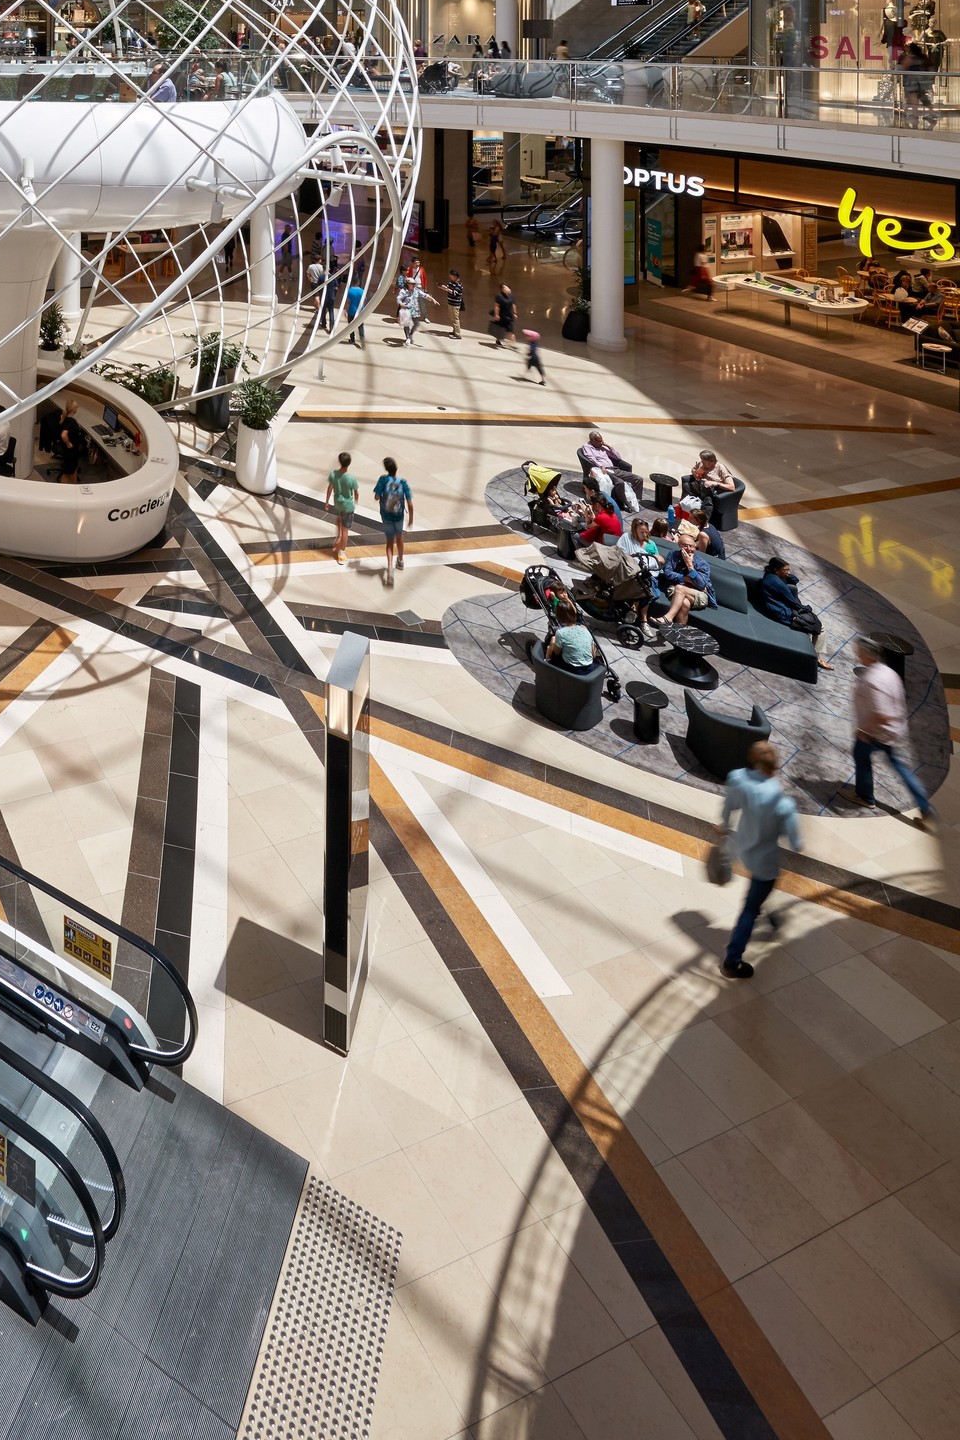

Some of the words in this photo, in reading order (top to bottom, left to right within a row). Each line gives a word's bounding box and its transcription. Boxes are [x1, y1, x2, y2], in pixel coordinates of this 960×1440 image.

[432, 34, 496, 46] ZARA
[624, 166, 705, 197] OPTUS
[837, 187, 956, 261] yes
[68, 920, 95, 940] WARNING
[90, 1021, 101, 1033] E22
